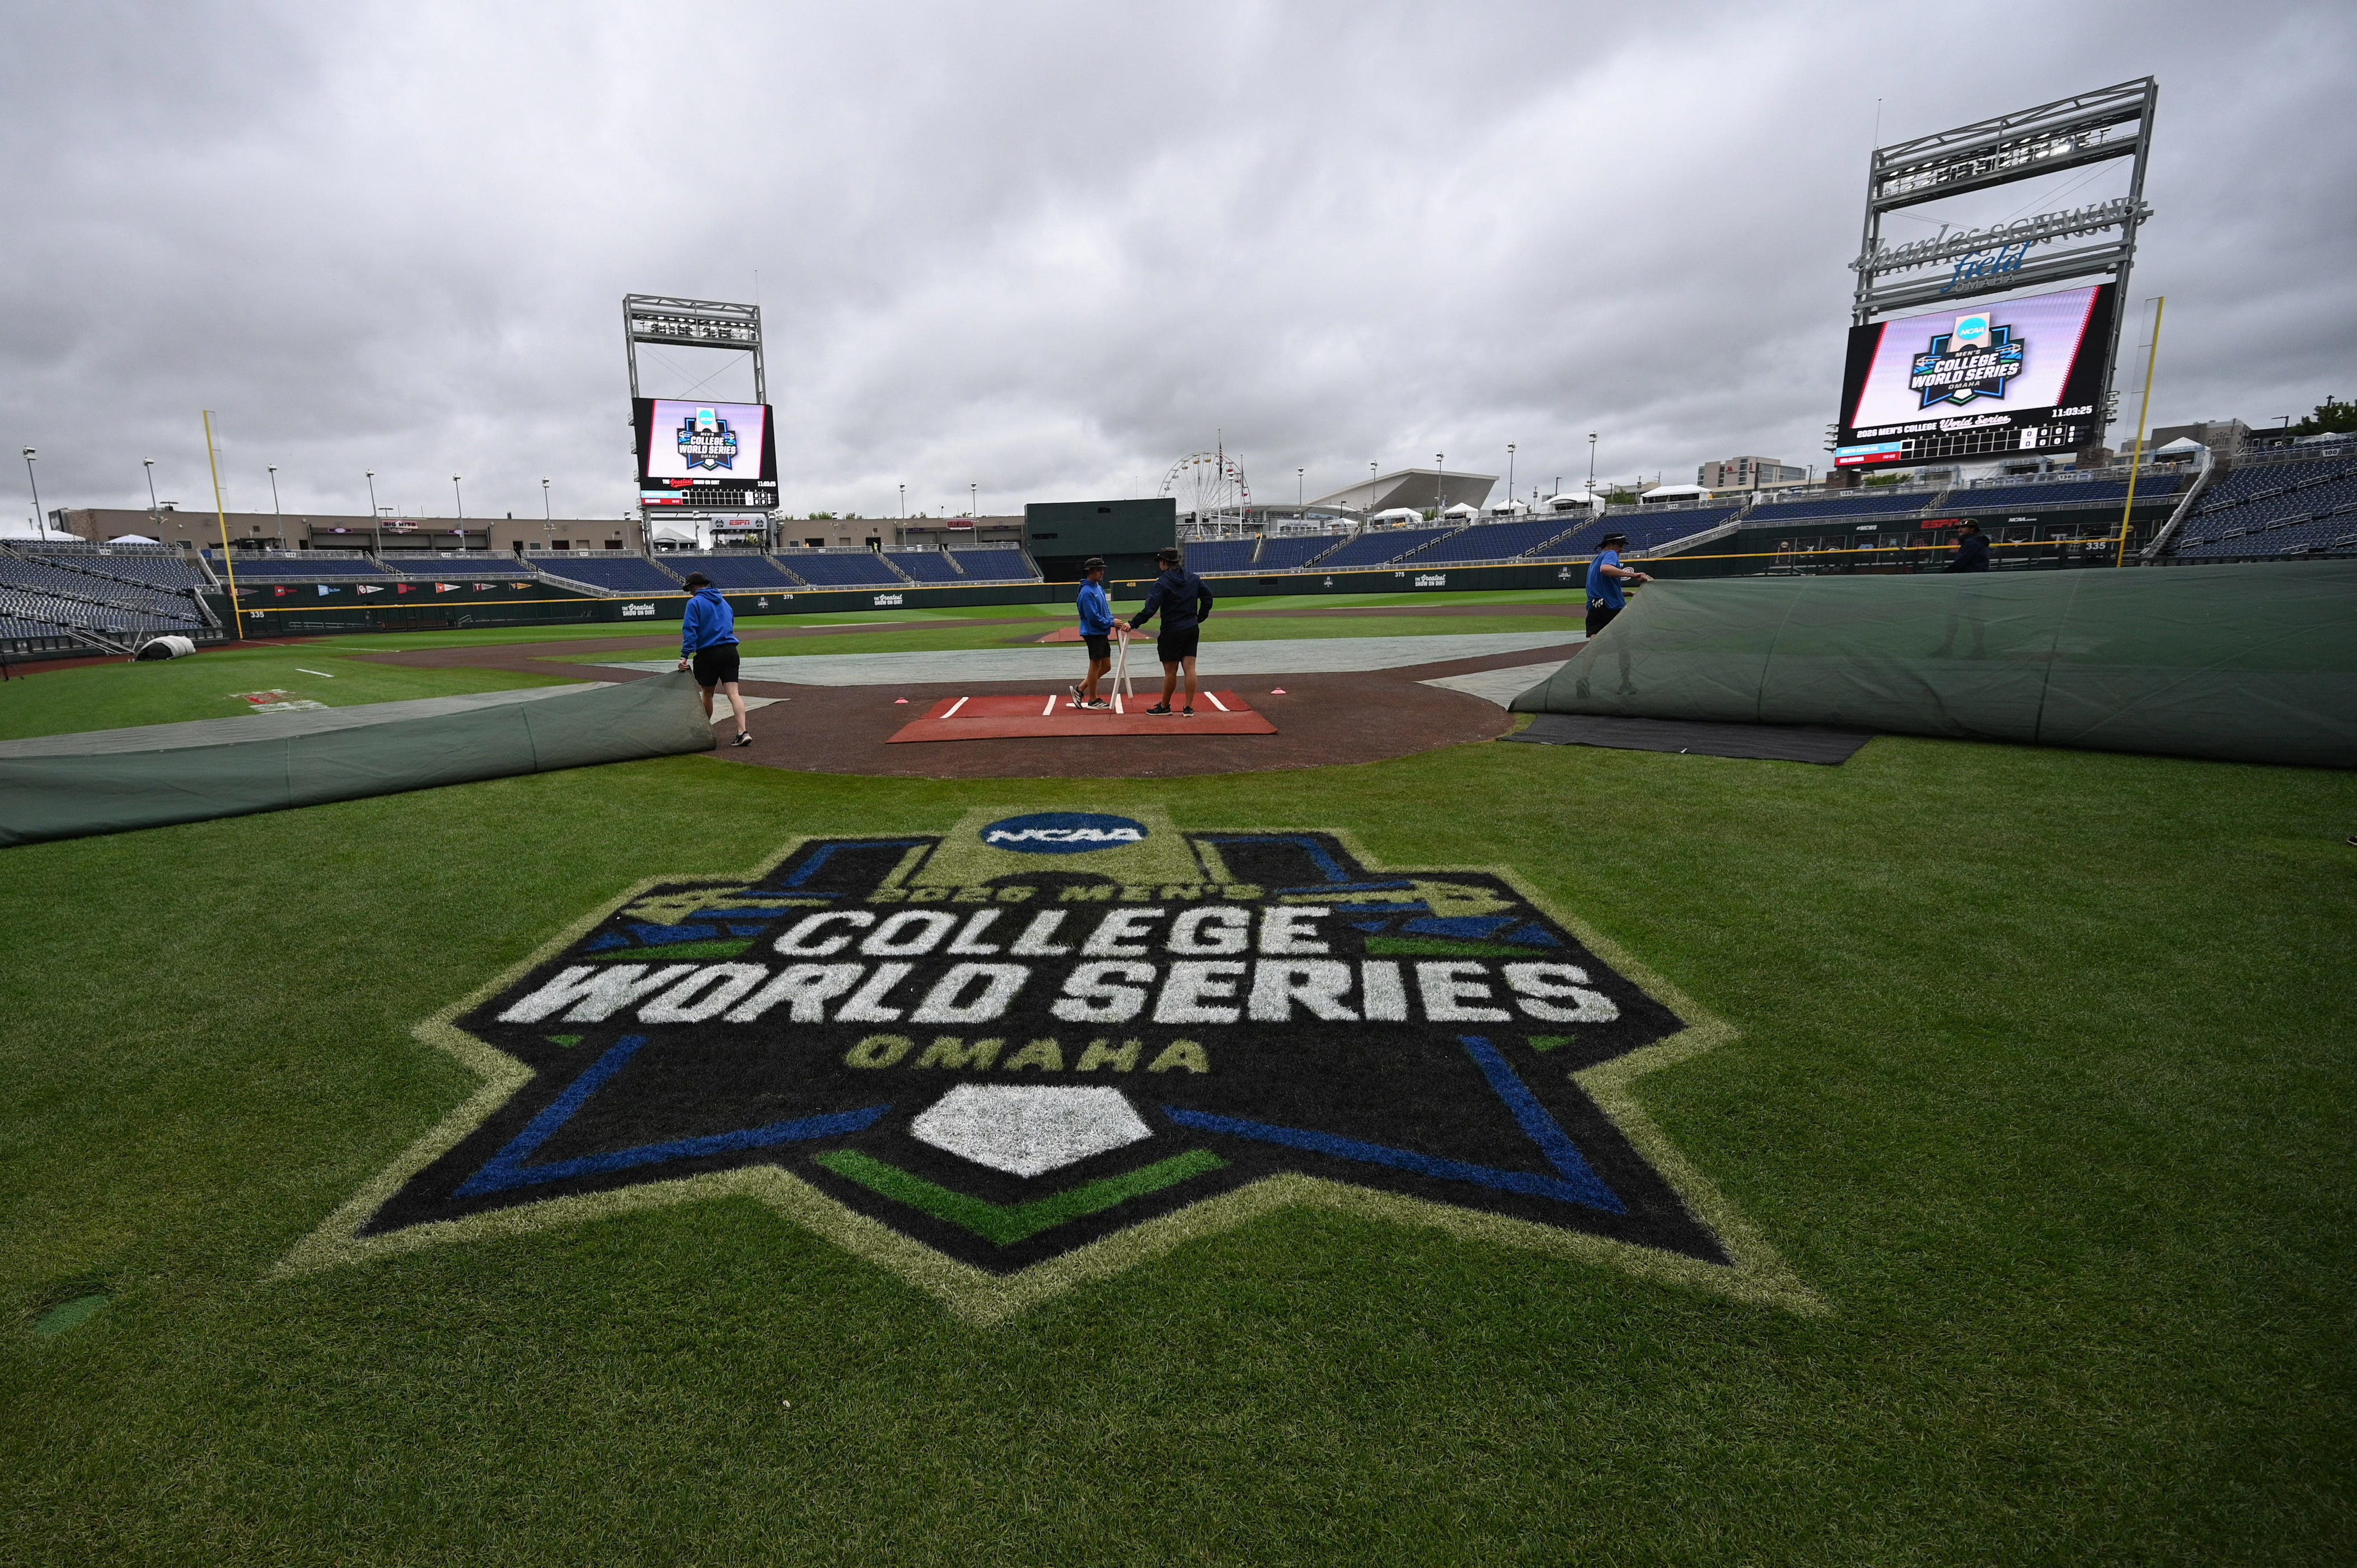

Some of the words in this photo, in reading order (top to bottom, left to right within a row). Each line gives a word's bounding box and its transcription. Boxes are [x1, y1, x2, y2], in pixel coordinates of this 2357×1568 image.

[1988, 195, 2140, 245] SCHWAB
[1940, 240, 2031, 293] field
[1956, 274, 2015, 292] OMAHA
[1960, 326, 1985, 336] NCAA
[1955, 349, 1981, 358] MEN'S
[1934, 353, 1999, 373] COLLEGE
[1911, 370, 1964, 389] WORLD
[1965, 363, 2020, 382] SERIES
[1948, 381, 1980, 390] OMAHA
[2051, 405, 2093, 417] 11:03:25
[1878, 426, 1903, 436] MEN'S
[1904, 422, 1937, 433] COLLEGE
[1939, 417, 1973, 430] World
[690, 436, 724, 446] COLLEGE
[678, 444, 707, 454] WORLD
[709, 445, 736, 455] SERIES
[2086, 541, 2106, 550] 335
[1421, 574, 1446, 582] Greatest
[628, 603, 655, 612] Greatest
[986, 828, 1144, 843] NCAA
[1058, 884, 1265, 902] MEN'S
[774, 905, 1331, 957] COLLEGE
[496, 961, 1032, 1024] WORLD
[1052, 957, 1619, 1024] SERIES
[842, 1033, 1211, 1074] OMAHA
